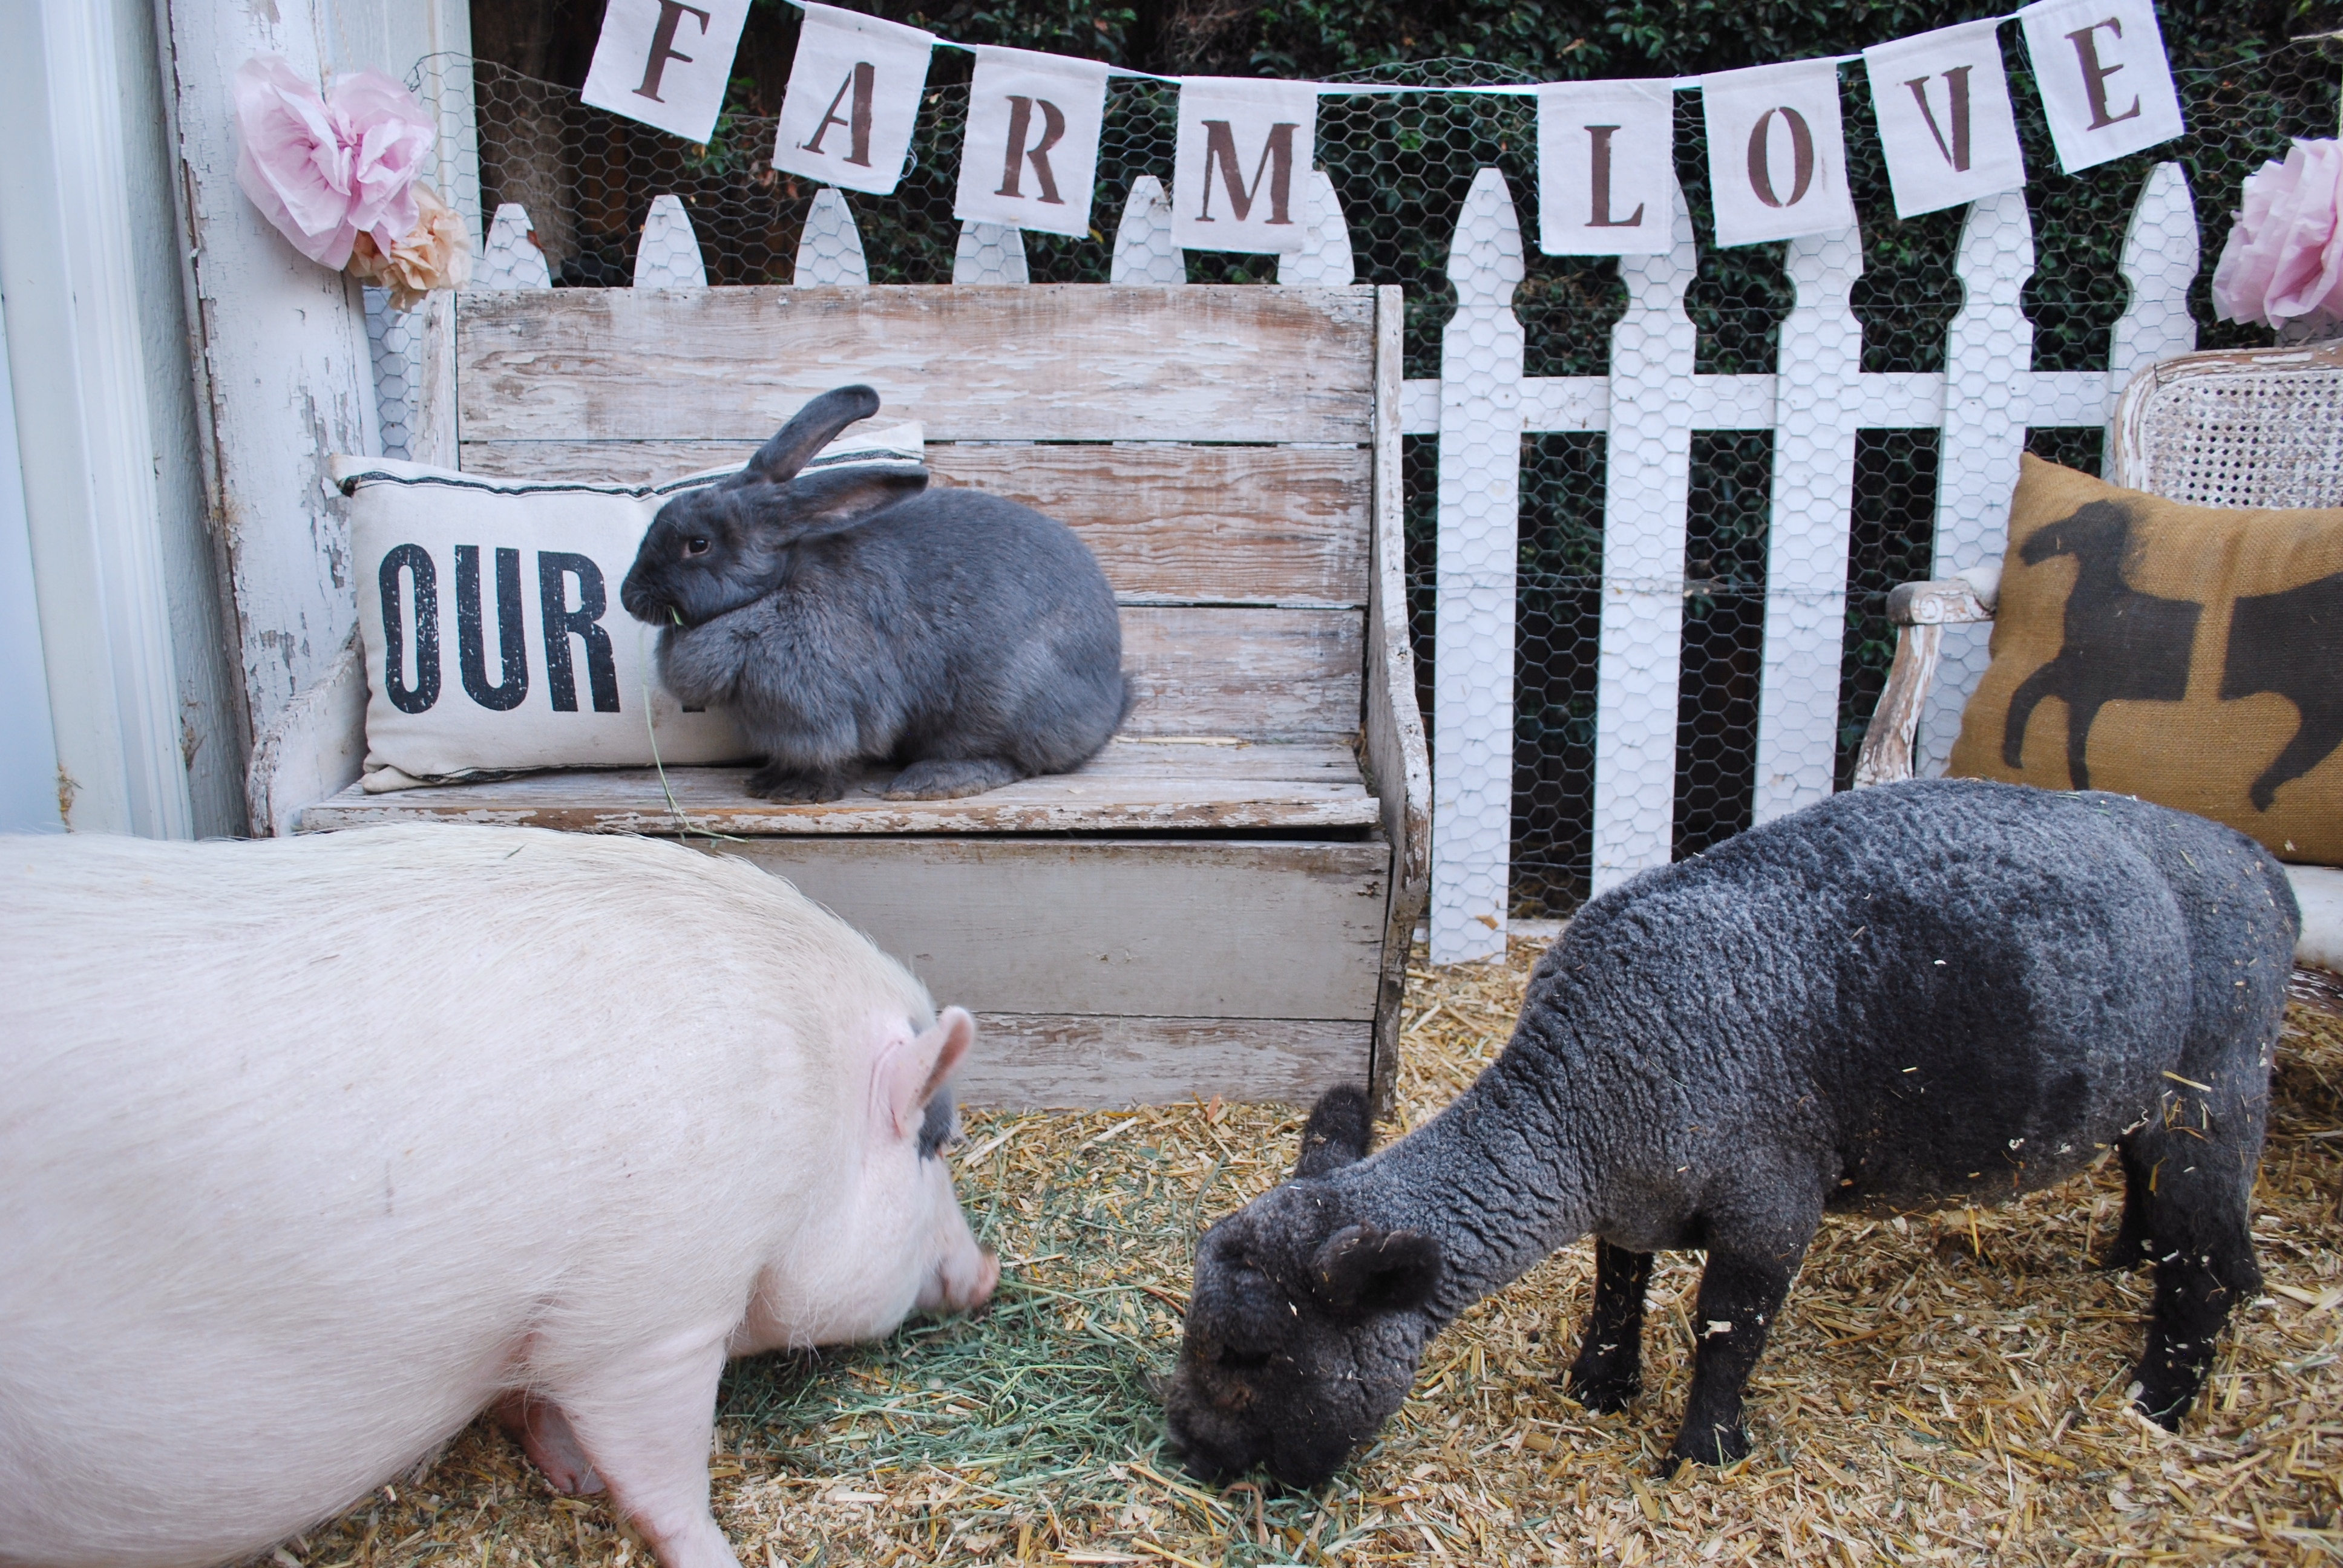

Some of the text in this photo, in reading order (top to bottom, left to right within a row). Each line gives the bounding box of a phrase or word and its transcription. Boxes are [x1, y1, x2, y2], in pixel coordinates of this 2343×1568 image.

[631, 0, 2141, 228] FARM LOVE
[379, 543, 621, 714] OUR
